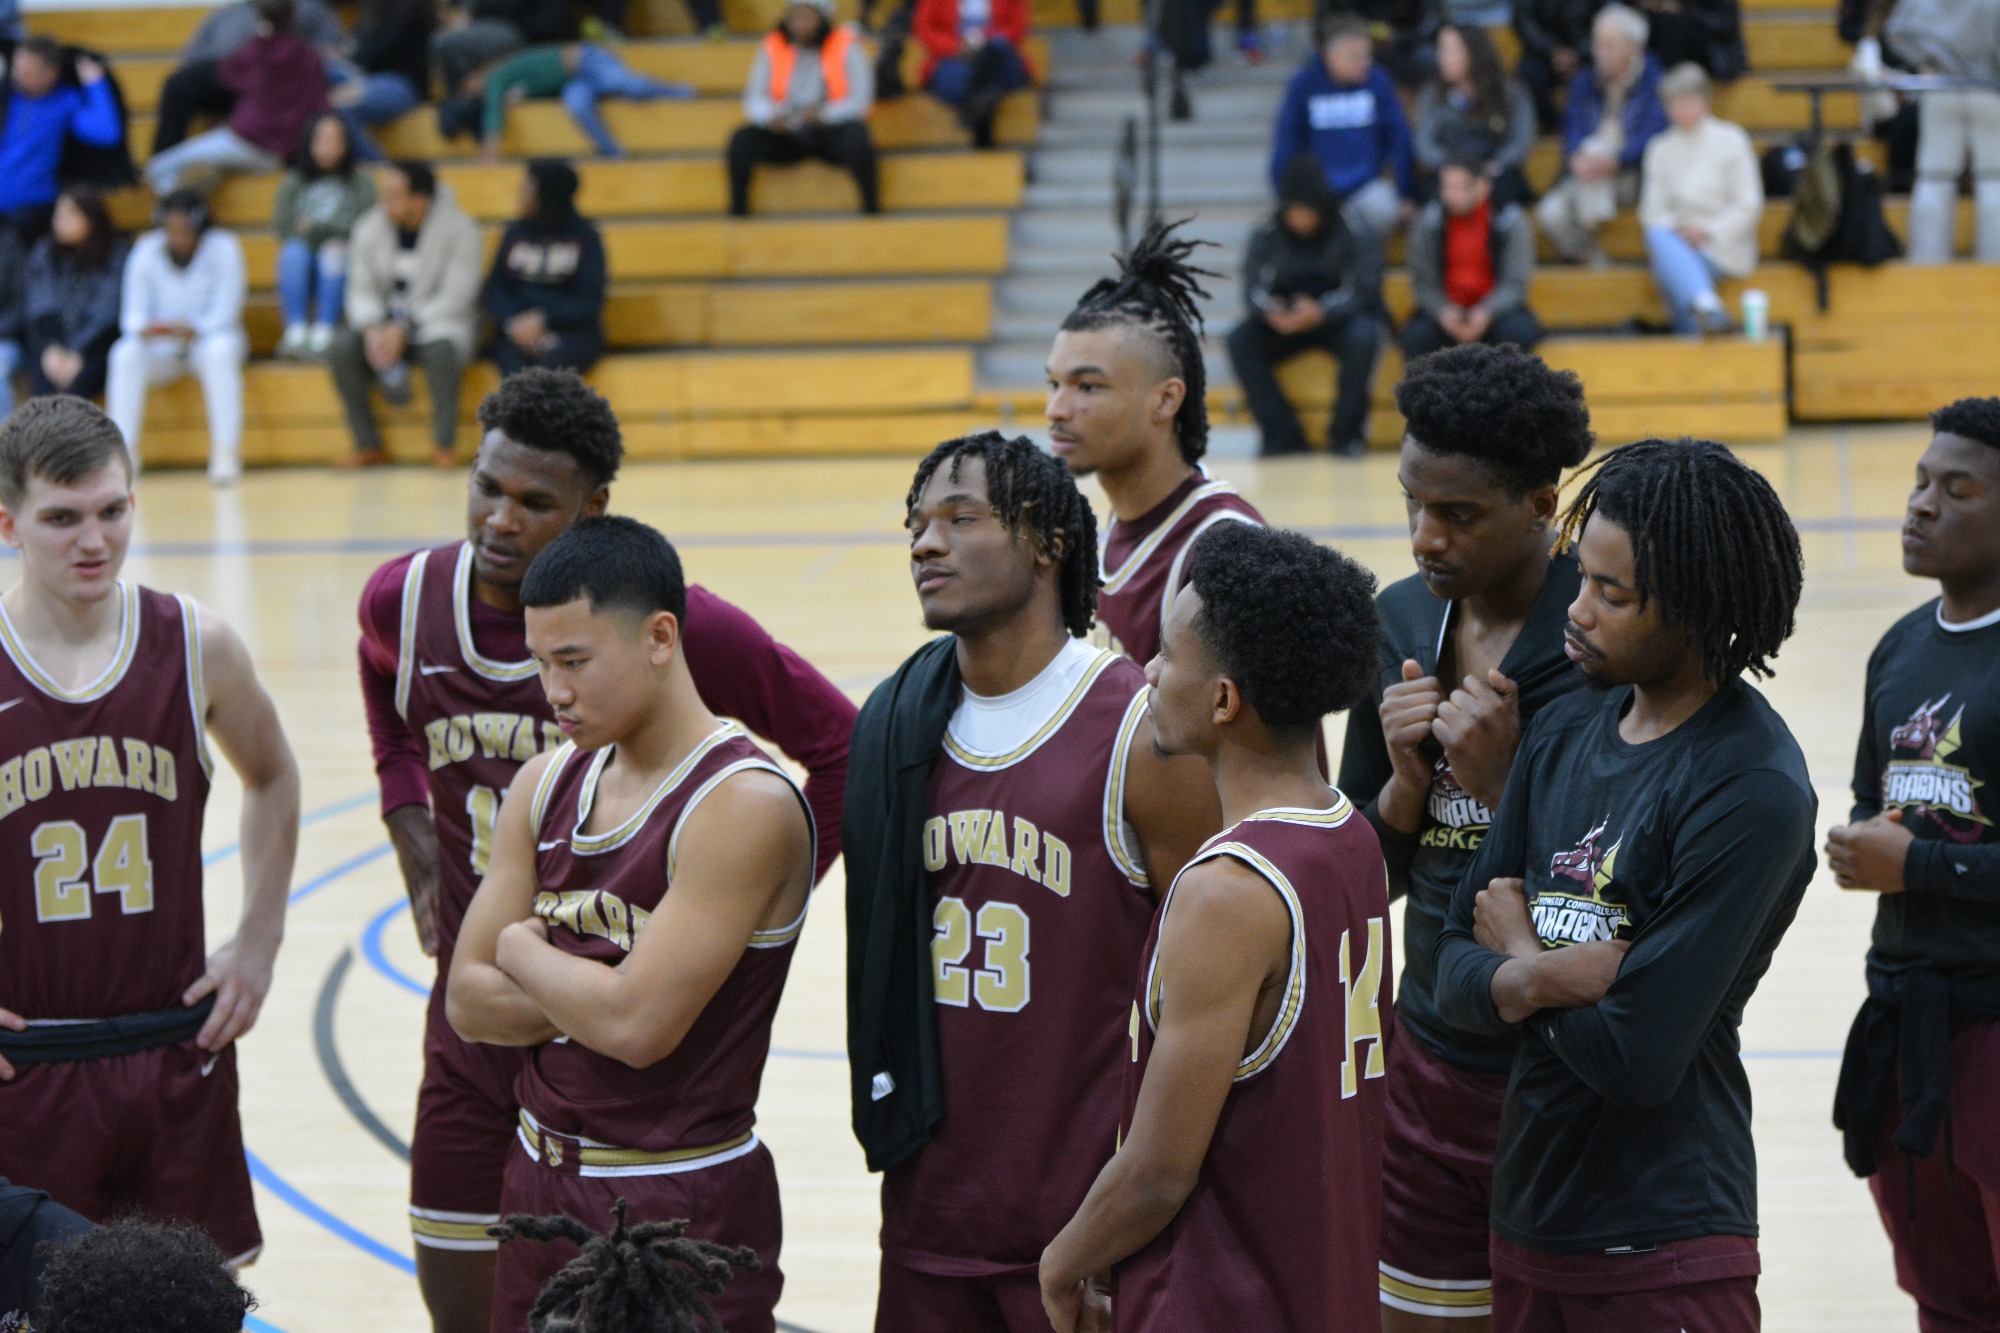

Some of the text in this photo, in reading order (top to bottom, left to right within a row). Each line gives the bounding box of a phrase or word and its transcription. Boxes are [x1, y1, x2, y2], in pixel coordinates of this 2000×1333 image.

[0, 735, 178, 820] HOWARD
[424, 712, 570, 771] HOWAR
[466, 784, 507, 876] 1
[1888, 773, 1972, 813] RAGONS
[31, 813, 154, 923] 24
[923, 809, 1071, 897] OWARD
[1420, 826, 1483, 850] ASKE
[931, 896, 1031, 1012] 23
[1339, 917, 1385, 1099] 14
